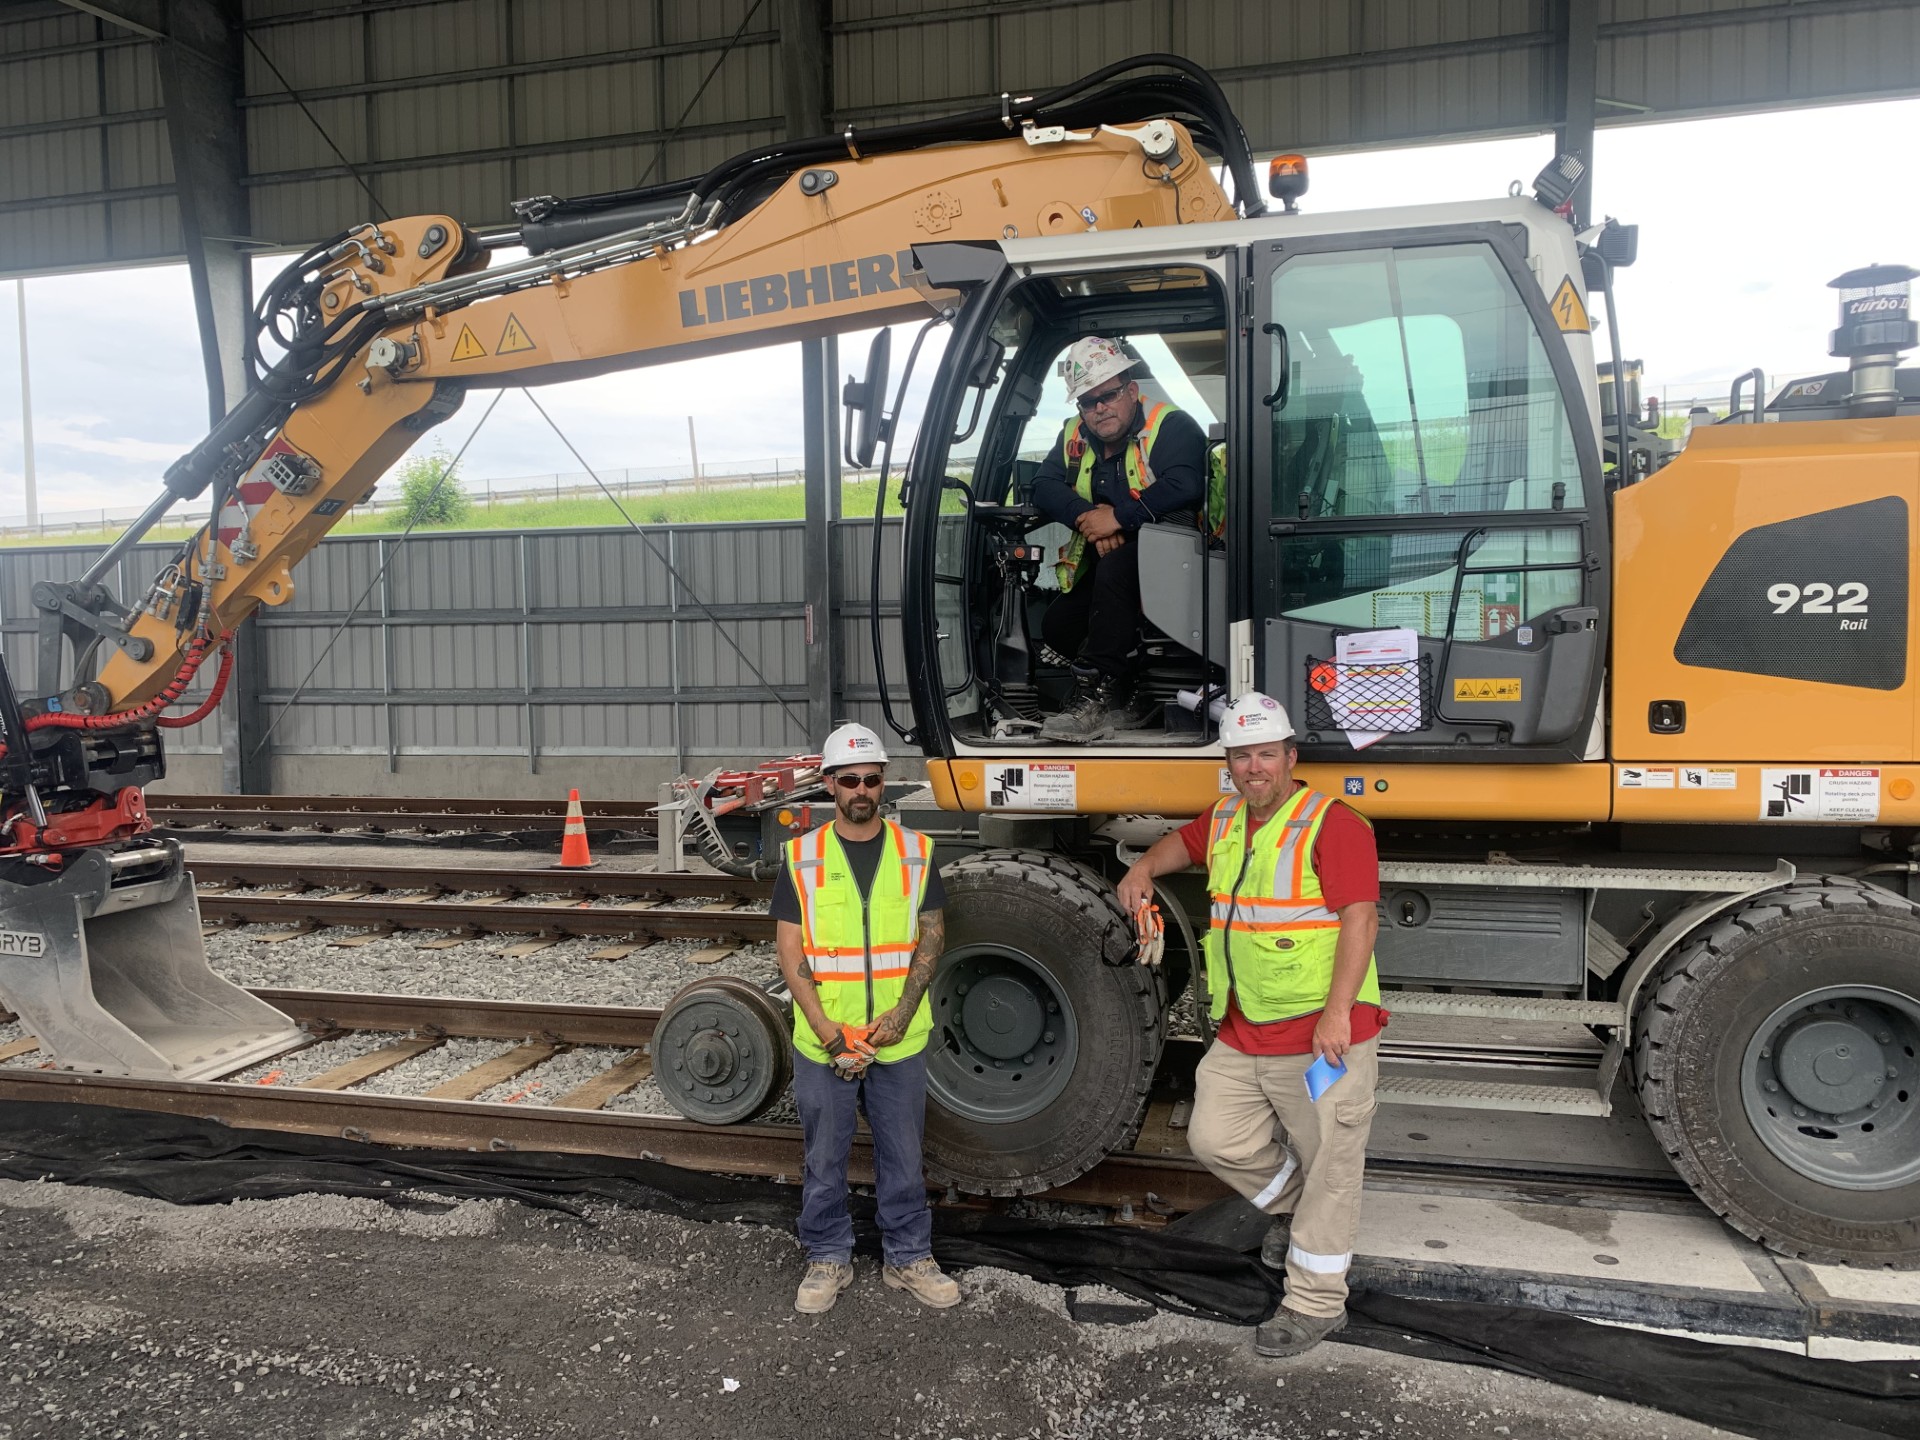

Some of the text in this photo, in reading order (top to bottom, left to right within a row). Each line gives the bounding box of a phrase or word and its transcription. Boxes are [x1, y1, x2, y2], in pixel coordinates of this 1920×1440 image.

[1850, 298, 1898, 314] turbo
[1767, 582, 1869, 614] 922
[1840, 619, 1868, 631] Rail
[0, 933, 41, 953] RYB
